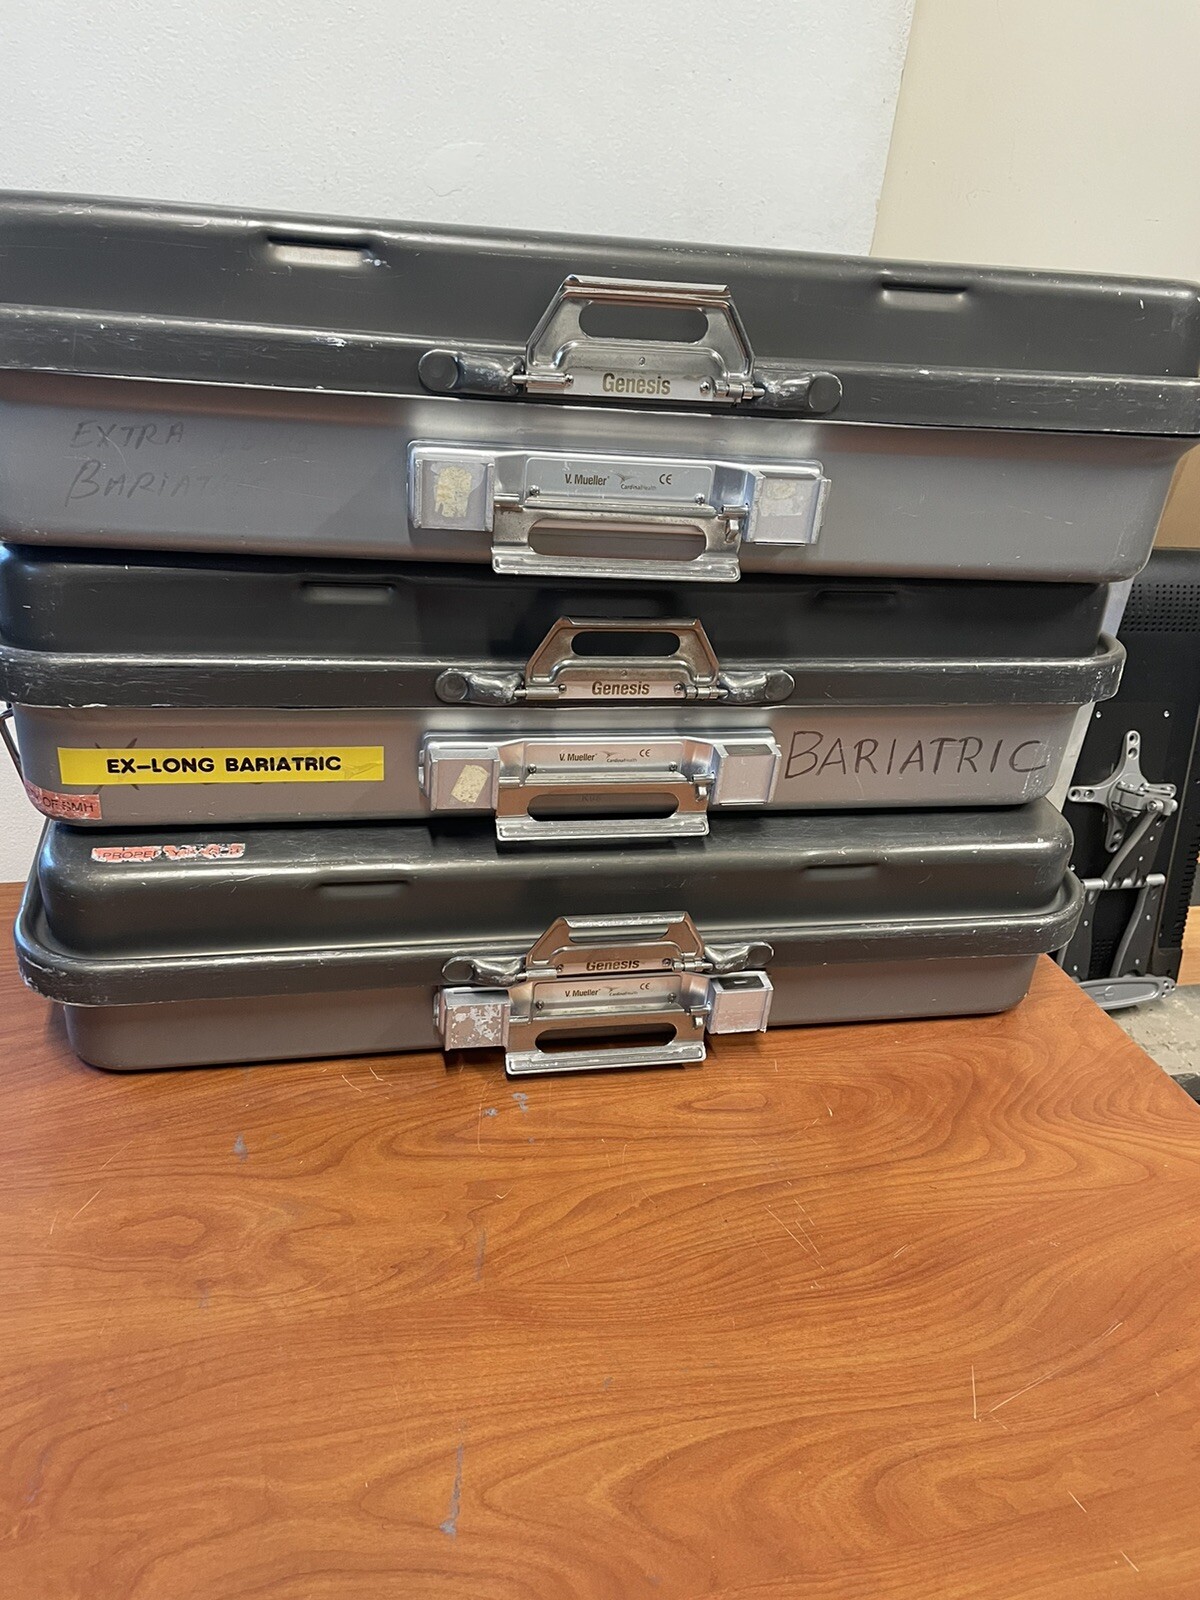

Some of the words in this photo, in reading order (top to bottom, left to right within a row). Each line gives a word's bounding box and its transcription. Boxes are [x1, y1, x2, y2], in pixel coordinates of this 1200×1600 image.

[602, 372, 671, 395] Genesis
[70, 420, 185, 449] EXTRA
[564, 473, 573, 484] V.
[574, 473, 607, 486] Mueller
[659, 473, 673, 485] CE
[591, 681, 650, 696] Genesis
[559, 753, 566, 762] V.
[567, 752, 595, 762] Mueller
[785, 731, 1047, 779] BARIATRIC
[107, 758, 215, 774] EX-LONG
[225, 756, 342, 772] BARIATRIC
[42, 796, 59, 809] OF
[586, 959, 640, 972] Genesis
[564, 990, 571, 998] V.
[572, 989, 598, 998] Mueller
